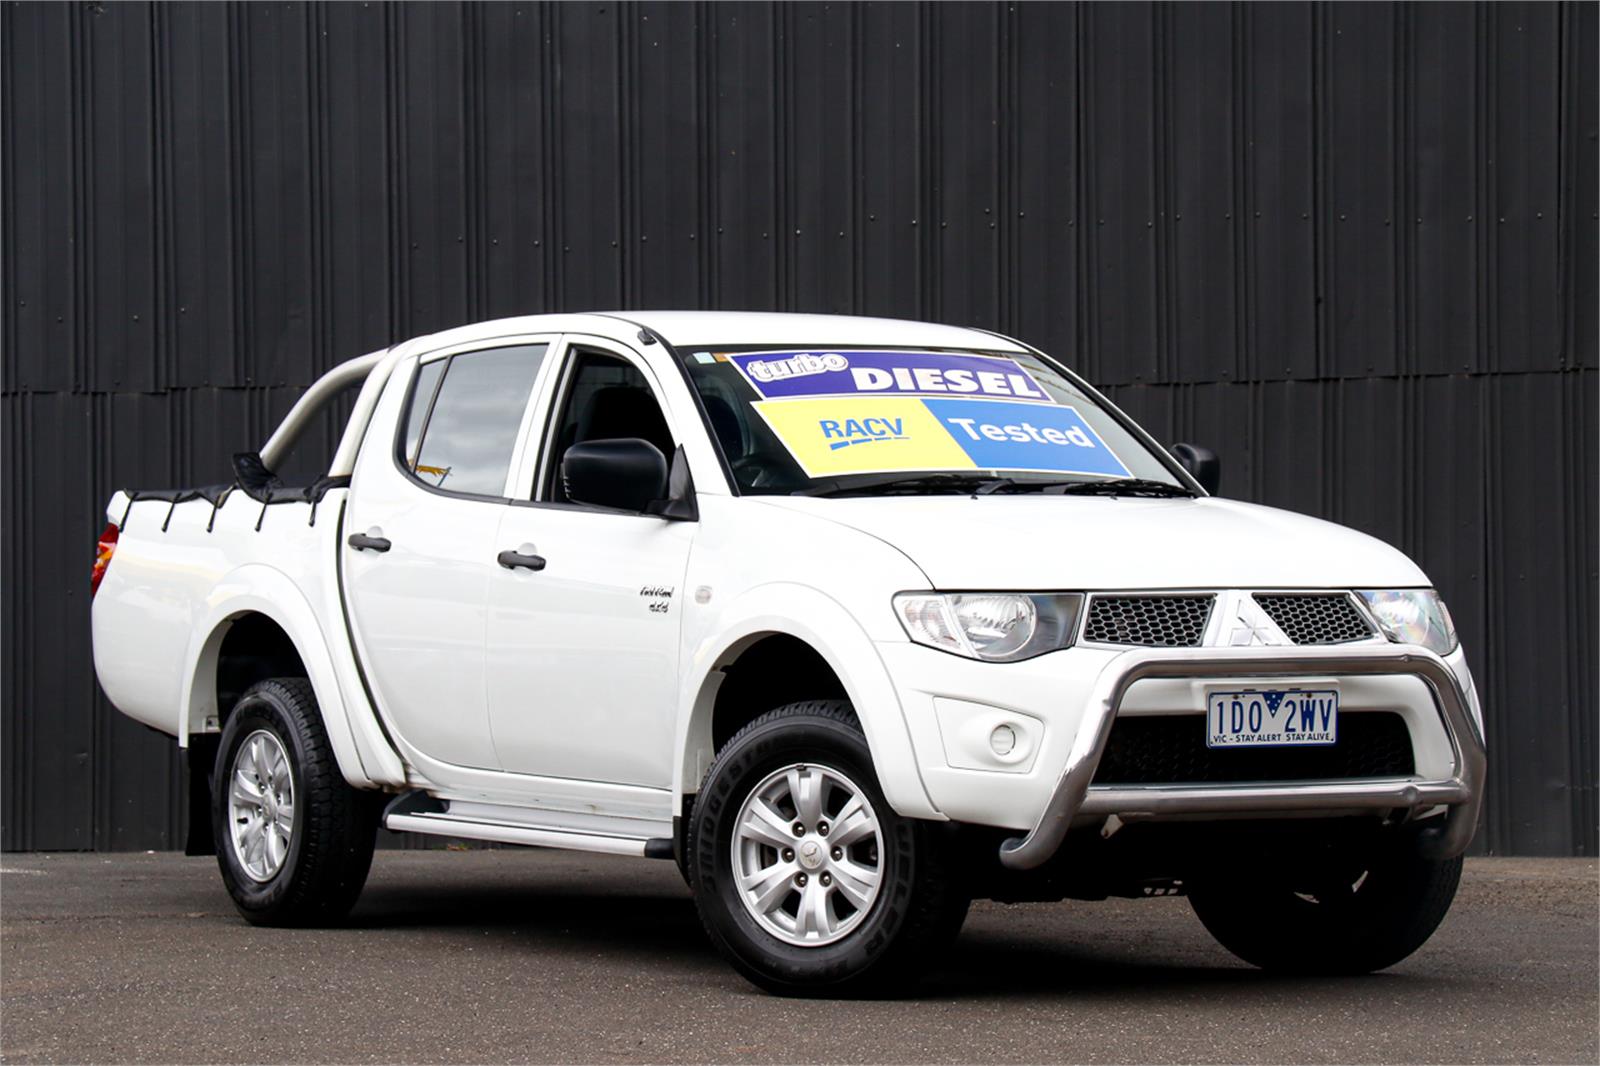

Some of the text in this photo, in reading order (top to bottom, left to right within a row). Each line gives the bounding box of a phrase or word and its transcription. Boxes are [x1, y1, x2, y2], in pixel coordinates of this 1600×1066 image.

[747, 354, 1041, 397] turbo DIESEL
[819, 418, 903, 438] RACV
[947, 418, 1096, 448] Tested
[1284, 699, 1332, 732] 2WV
[1213, 734, 1227, 743] VIC
[1236, 733, 1257, 743] STAY
[1256, 733, 1282, 742] ALERT
[1286, 733, 1306, 741] STAY
[1306, 732, 1330, 741] ALIVE
